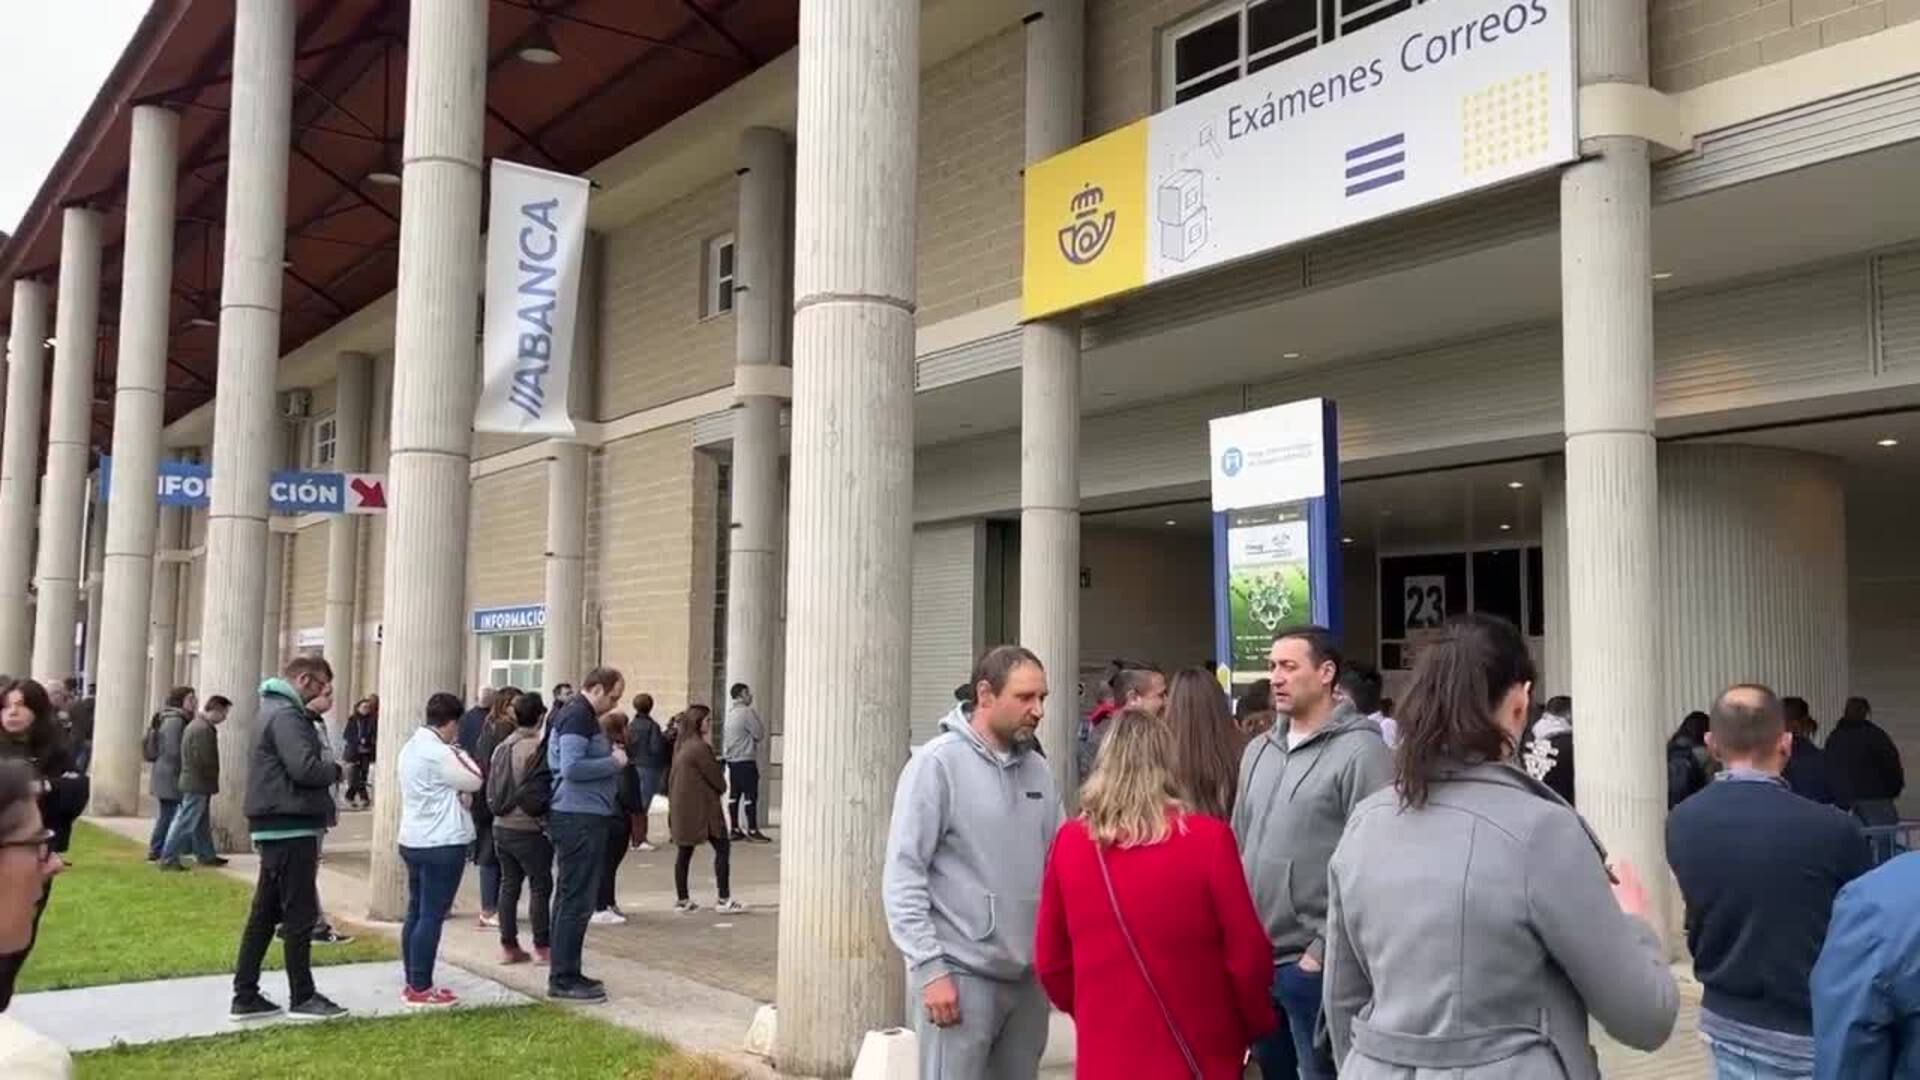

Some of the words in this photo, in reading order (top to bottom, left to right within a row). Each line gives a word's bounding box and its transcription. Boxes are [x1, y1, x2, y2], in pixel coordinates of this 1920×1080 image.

[1228, 58, 1384, 139] Exámenes
[1401, 0, 1548, 72] Correos
[1406, 585, 1444, 627] 23
